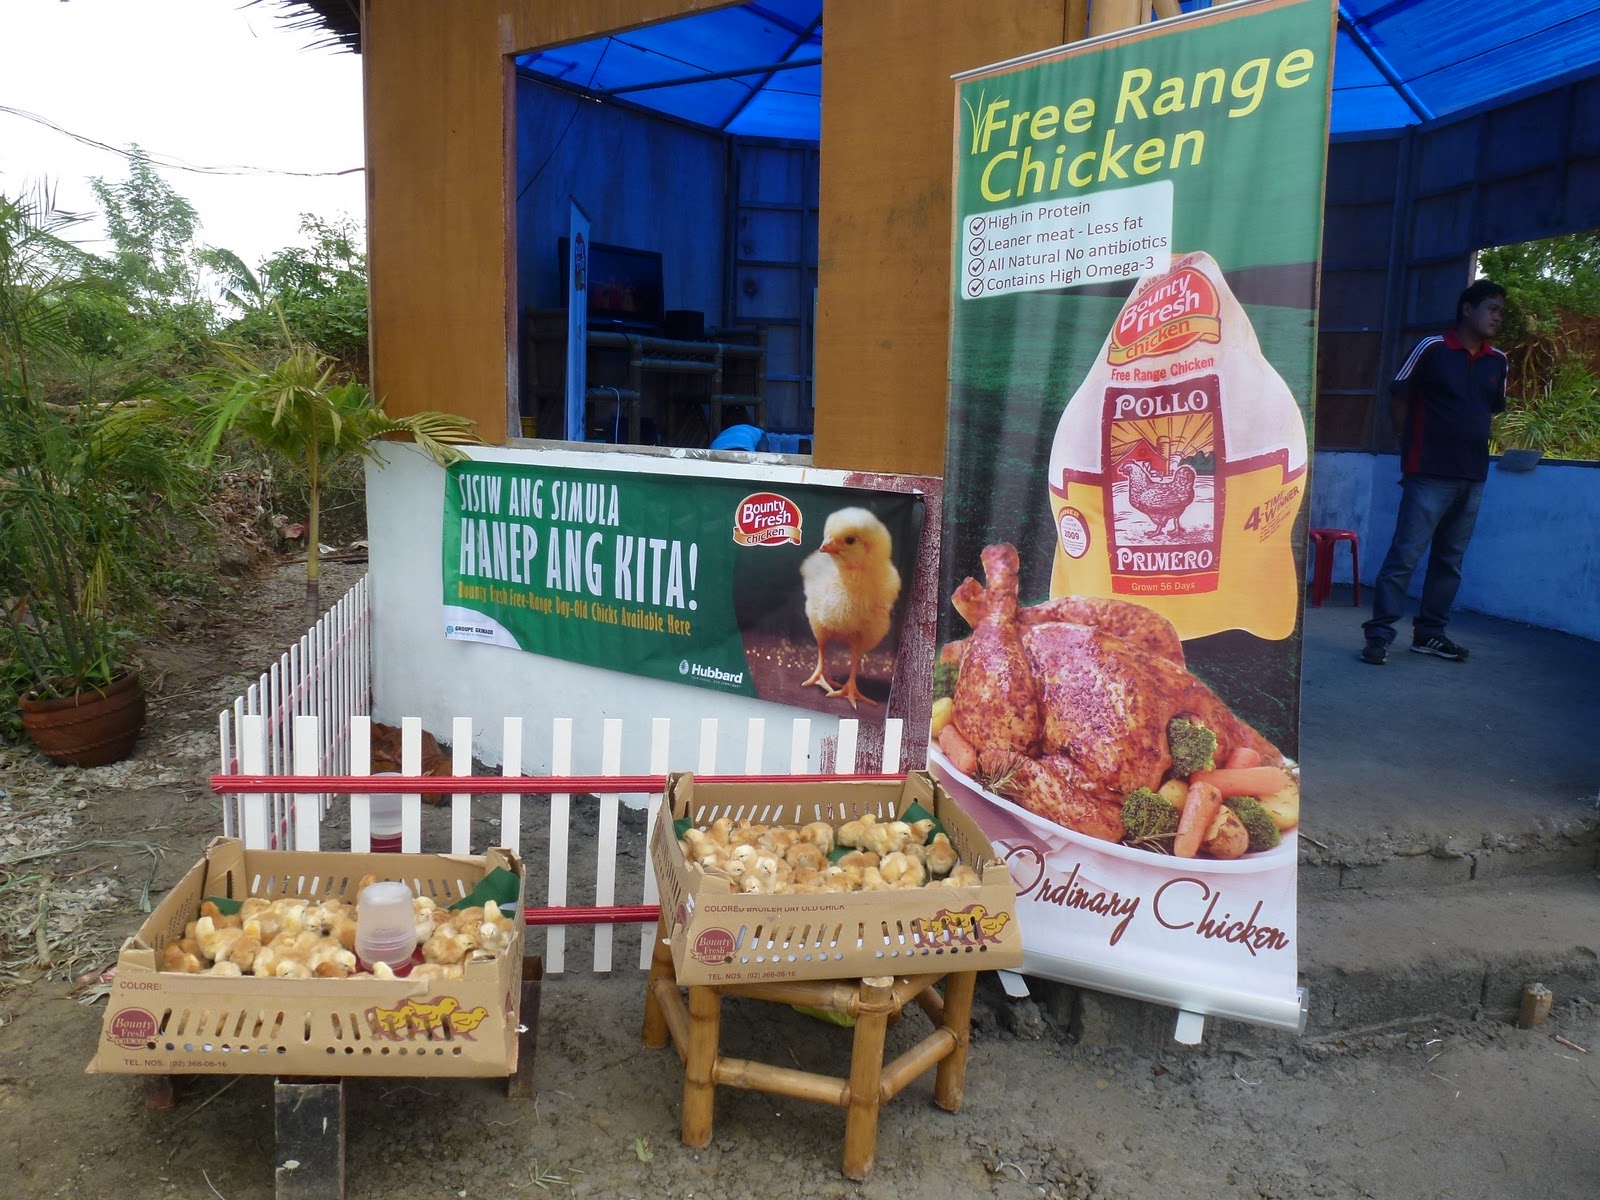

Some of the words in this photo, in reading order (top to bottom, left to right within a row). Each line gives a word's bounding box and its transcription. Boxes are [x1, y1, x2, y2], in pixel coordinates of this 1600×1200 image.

[979, 96, 1095, 154] Free
[1113, 48, 1315, 124] Range
[979, 129, 1205, 202] Chicken
[988, 214, 1017, 230] High
[1021, 211, 1033, 223] in
[1038, 201, 1091, 221] Protein
[988, 233, 1032, 251] Leaner
[1036, 227, 1074, 244] meat
[1087, 222, 1119, 236] Less
[1123, 215, 1143, 231] fat
[987, 256, 1005, 272] All
[1008, 252, 1060, 269] Natural
[1065, 247, 1084, 261] No
[1088, 235, 1168, 258] antibiotics
[987, 272, 1045, 292] Contains
[1050, 266, 1081, 284] High
[1086, 255, 1154, 278] Omega-3
[1119, 273, 1192, 334] Bounty
[1111, 368, 1131, 381] Free
[1133, 368, 1167, 382] Range
[1170, 357, 1214, 377] Chicken
[1113, 389, 1208, 419] POLLO
[458, 473, 502, 514] SISIW
[509, 477, 543, 519] ANG
[551, 480, 619, 527] SIMULA
[742, 500, 786, 524] Bounty
[1064, 530, 1080, 540] 2009
[460, 517, 538, 585] HANEP
[546, 526, 603, 597] ANG
[615, 534, 698, 611] KITA!
[1116, 547, 1213, 571] PRIMERO
[1131, 582, 1158, 591] Grown
[1160, 582, 1172, 590] 56
[1174, 581, 1196, 592] Days
[458, 580, 487, 603] Bounty
[490, 585, 508, 605] Fresh
[509, 588, 553, 614] Free-Range
[555, 596, 588, 619] Day-Old
[591, 601, 618, 625] Chicks
[621, 606, 664, 633] Available
[667, 613, 691, 636] Here
[691, 663, 744, 684] Hubbard
[1003, 845, 1140, 946] Ordinary
[1153, 877, 1290, 957] Chicken
[699, 937, 732, 949] Bounty
[704, 946, 726, 954] Fresh
[120, 981, 162, 991] COLORE
[115, 1017, 154, 1030] Bounty
[121, 1028, 147, 1038] Fresh
[169, 1060, 186, 1068] (02)
